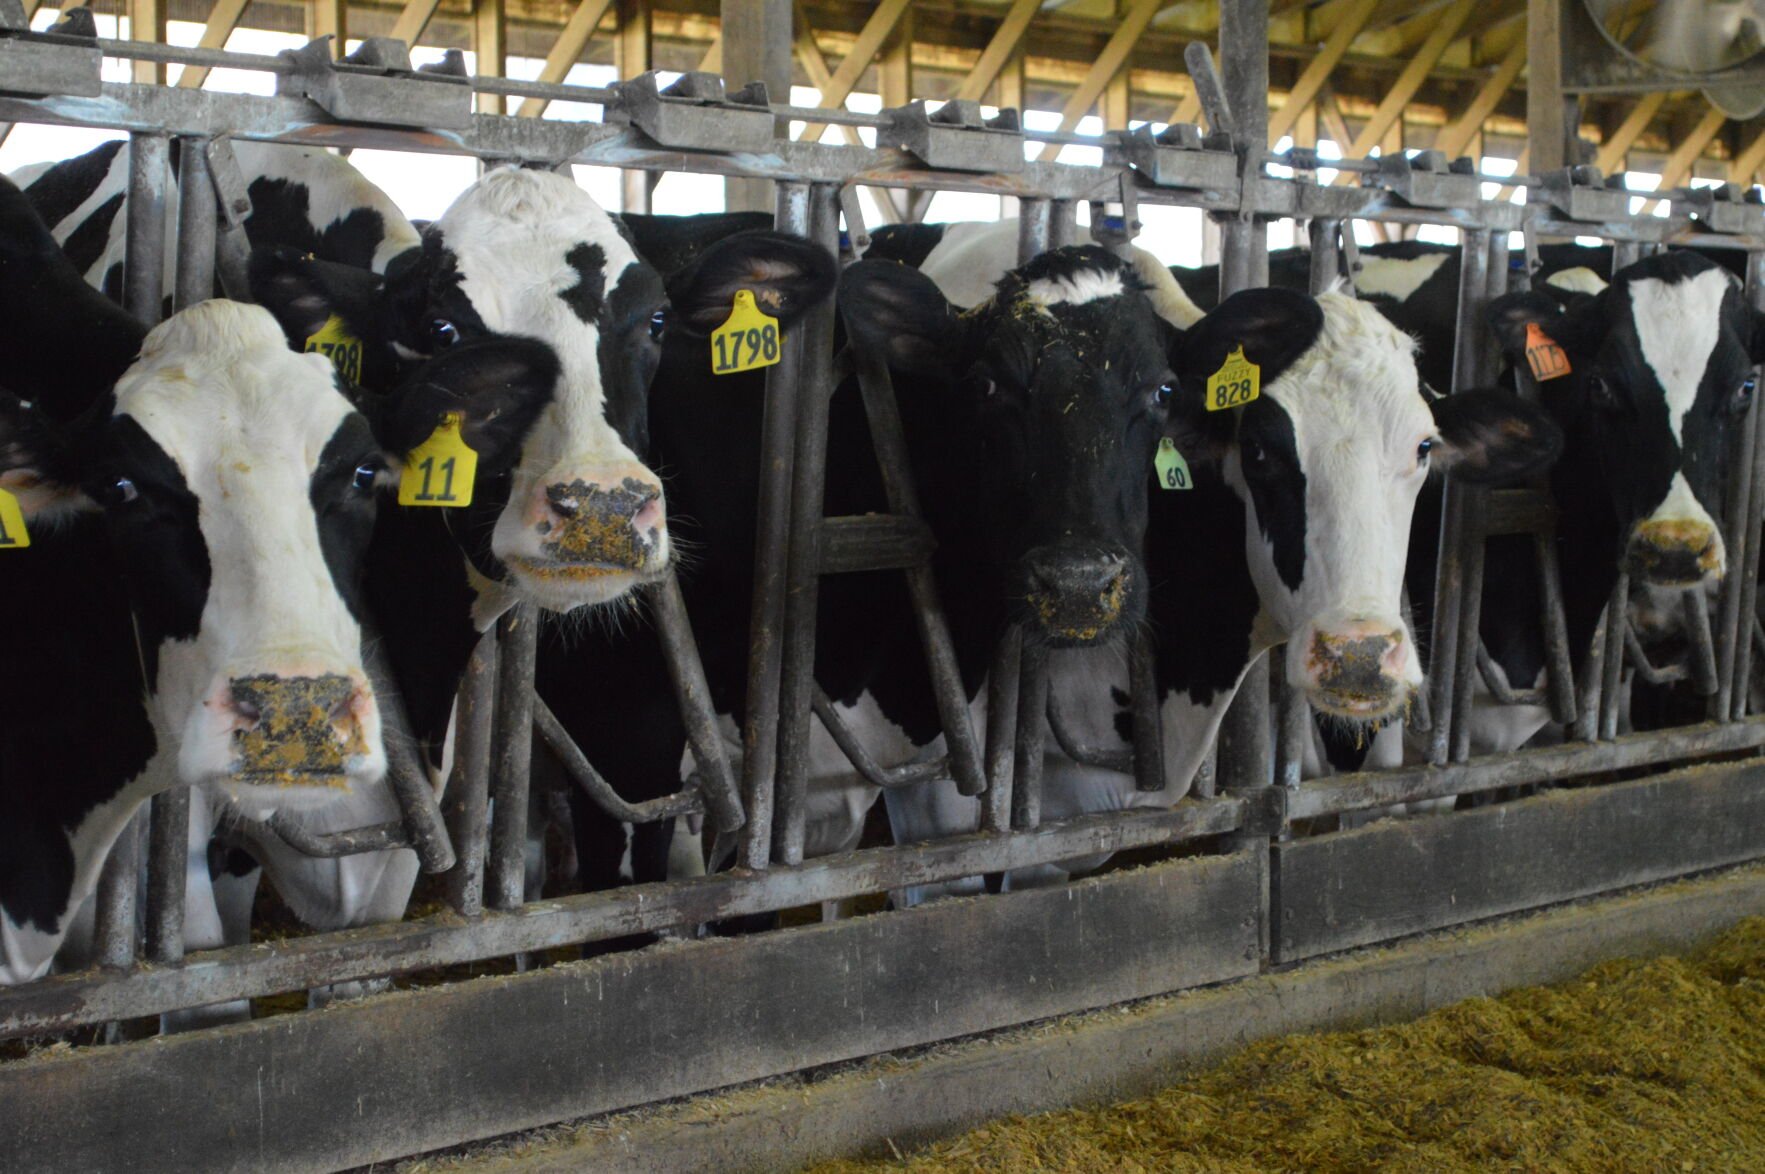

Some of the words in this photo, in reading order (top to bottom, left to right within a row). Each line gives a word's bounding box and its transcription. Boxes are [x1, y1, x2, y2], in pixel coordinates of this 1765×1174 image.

[305, 342, 361, 386] 98
[714, 324, 778, 371] 1798
[1215, 379, 1251, 407] 828
[1217, 368, 1250, 383] FUZZY
[414, 456, 457, 501] 11
[1167, 466, 1186, 488] 60
